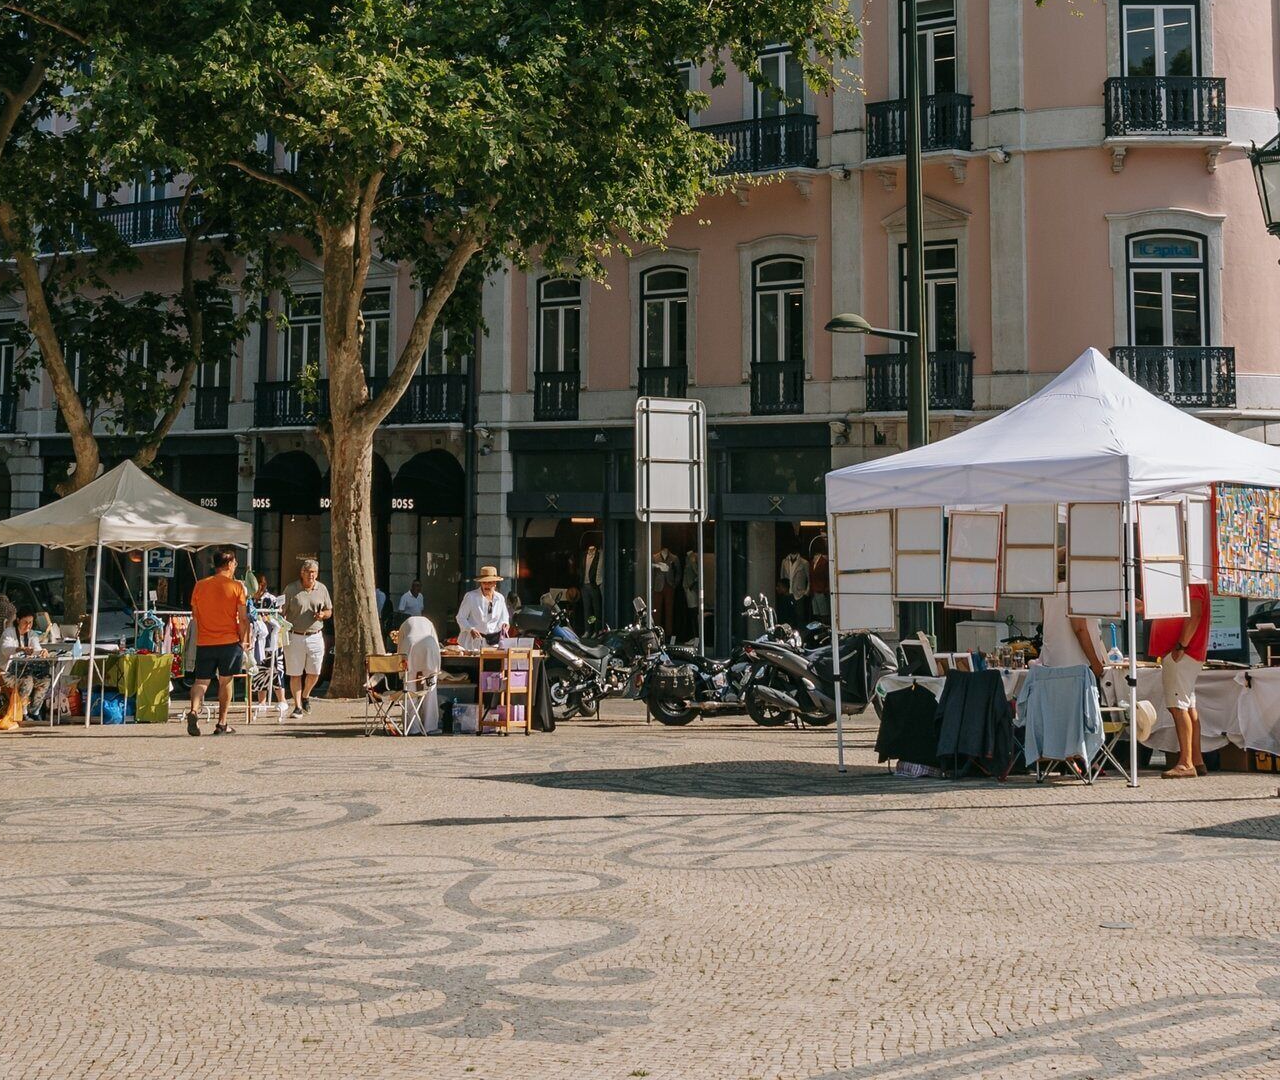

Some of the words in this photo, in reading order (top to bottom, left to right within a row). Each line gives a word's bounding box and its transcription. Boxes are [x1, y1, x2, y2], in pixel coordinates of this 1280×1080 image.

[1139, 241, 1193, 257] iCapital
[200, 497, 218, 507] BOSS
[252, 497, 271, 508] BOSS
[319, 497, 332, 508] BO
[391, 497, 414, 509] BOSS
